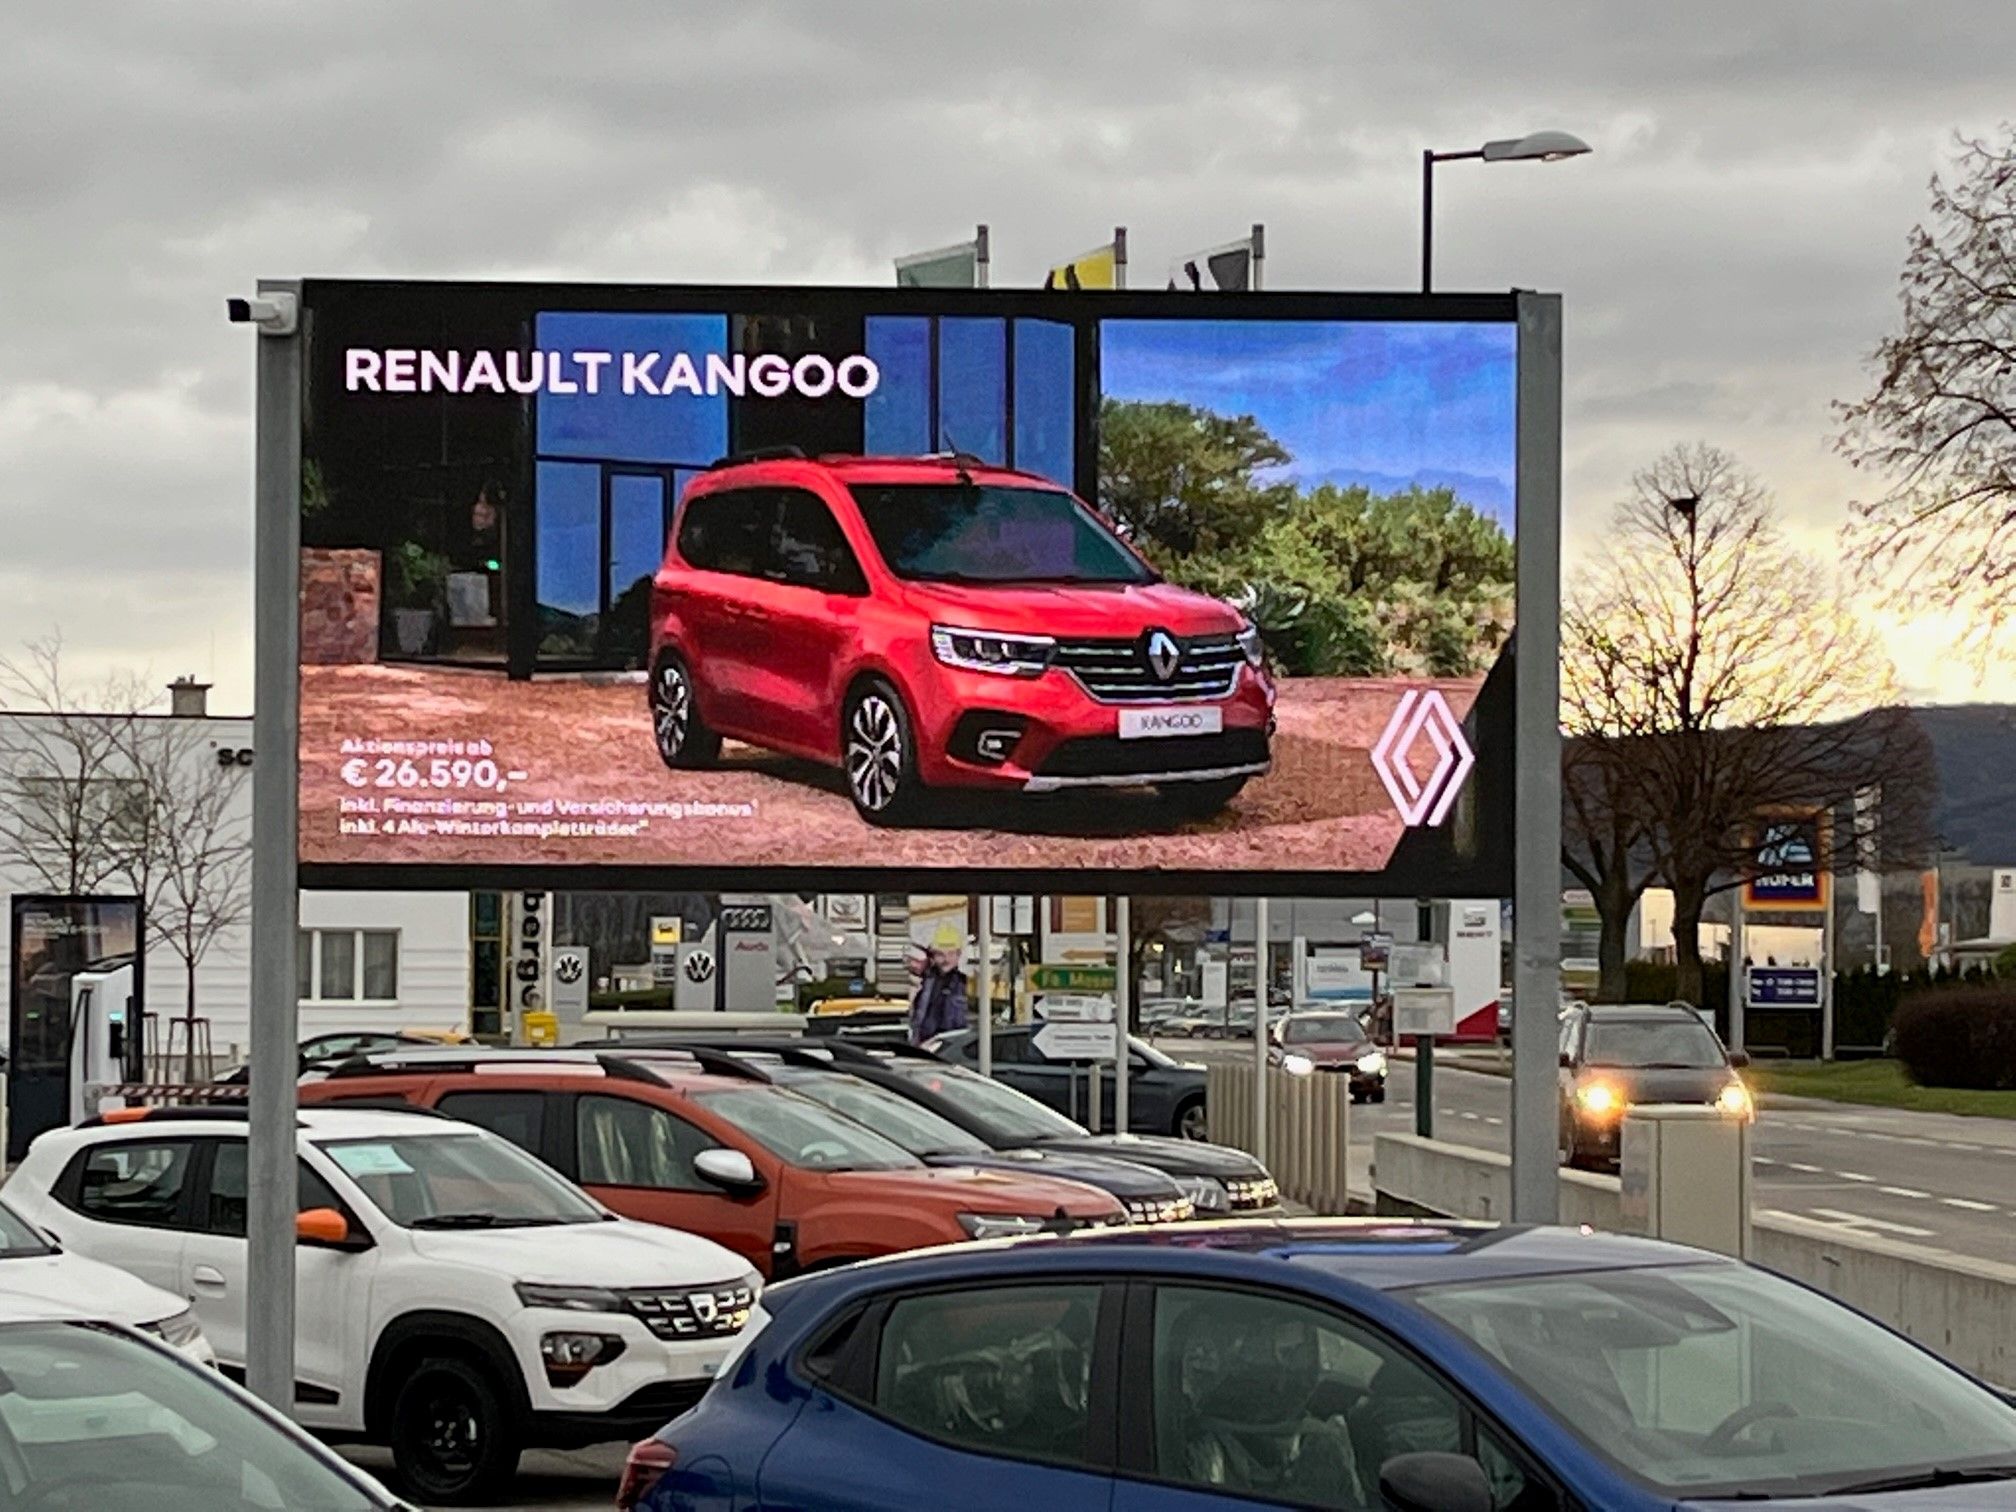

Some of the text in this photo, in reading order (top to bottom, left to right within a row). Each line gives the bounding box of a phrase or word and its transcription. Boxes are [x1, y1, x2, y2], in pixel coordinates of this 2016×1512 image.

[345, 348, 880, 398] RENAULT KANGOO
[1141, 713, 1203, 729] KANGOO
[340, 739, 494, 757] Aktionspreis ab
[340, 758, 369, 788] €
[516, 798, 554, 815] und
[382, 819, 396, 834] 4
